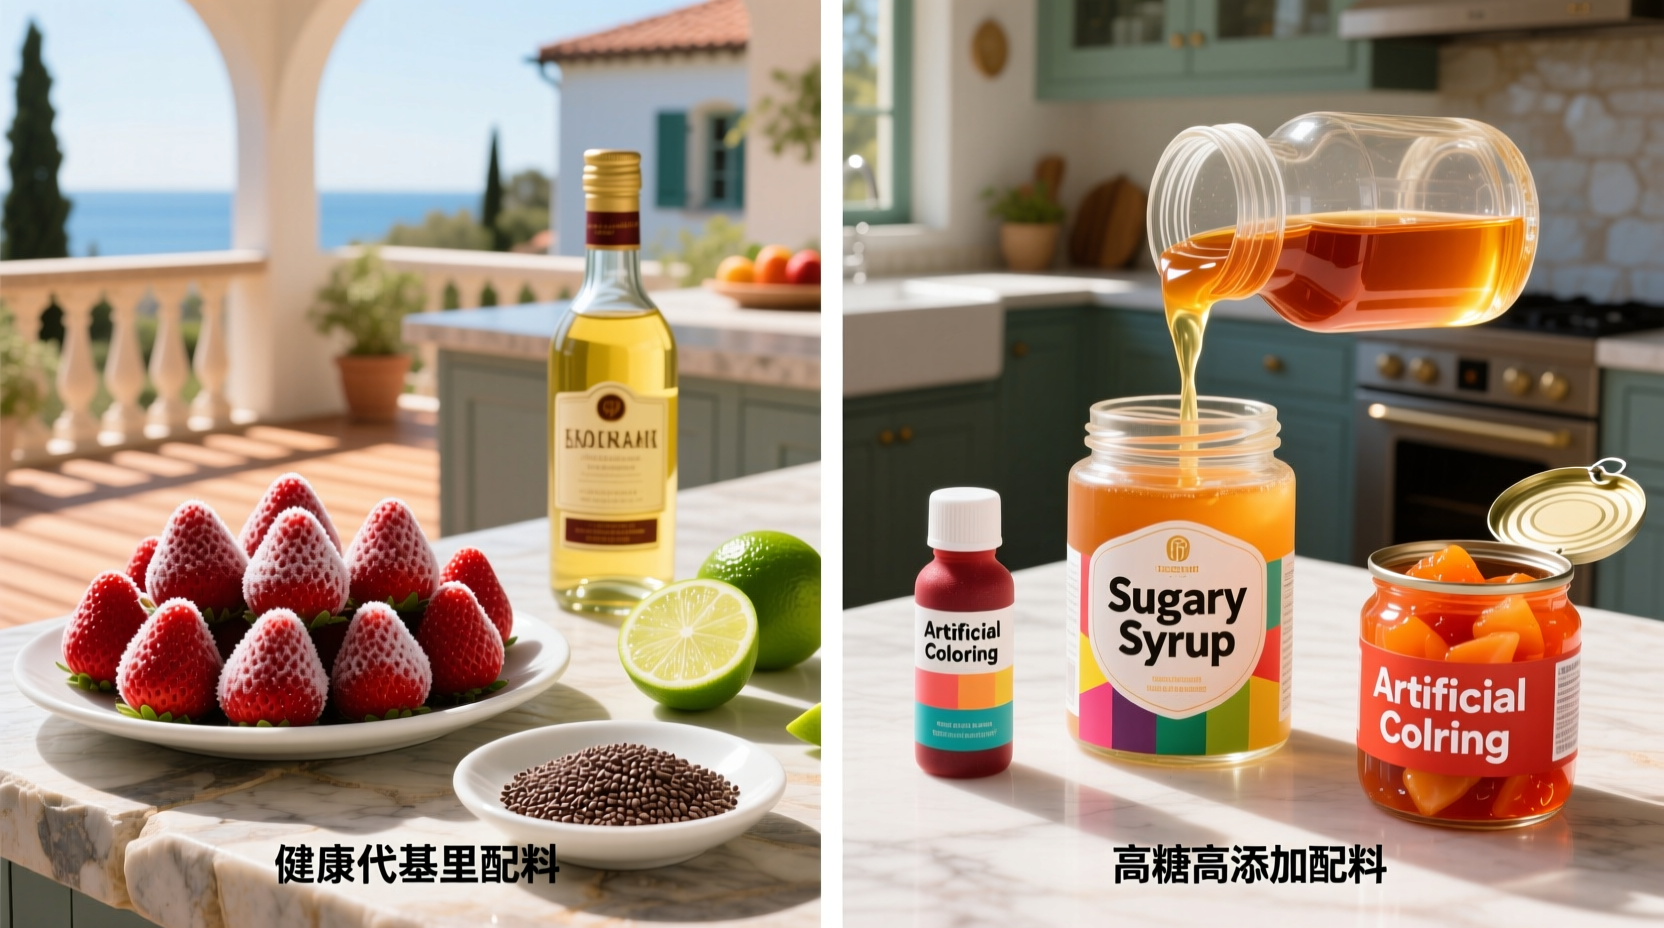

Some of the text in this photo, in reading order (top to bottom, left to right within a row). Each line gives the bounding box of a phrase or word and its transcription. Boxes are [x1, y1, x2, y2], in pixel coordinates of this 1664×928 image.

[1108, 576, 1248, 626] Sugary
[924, 620, 1001, 642] Artificial
[925, 642, 998, 666] Coloring
[1118, 619, 1236, 667] Syrup
[1373, 666, 1526, 714] Artificial
[1380, 710, 1510, 764] Colring
